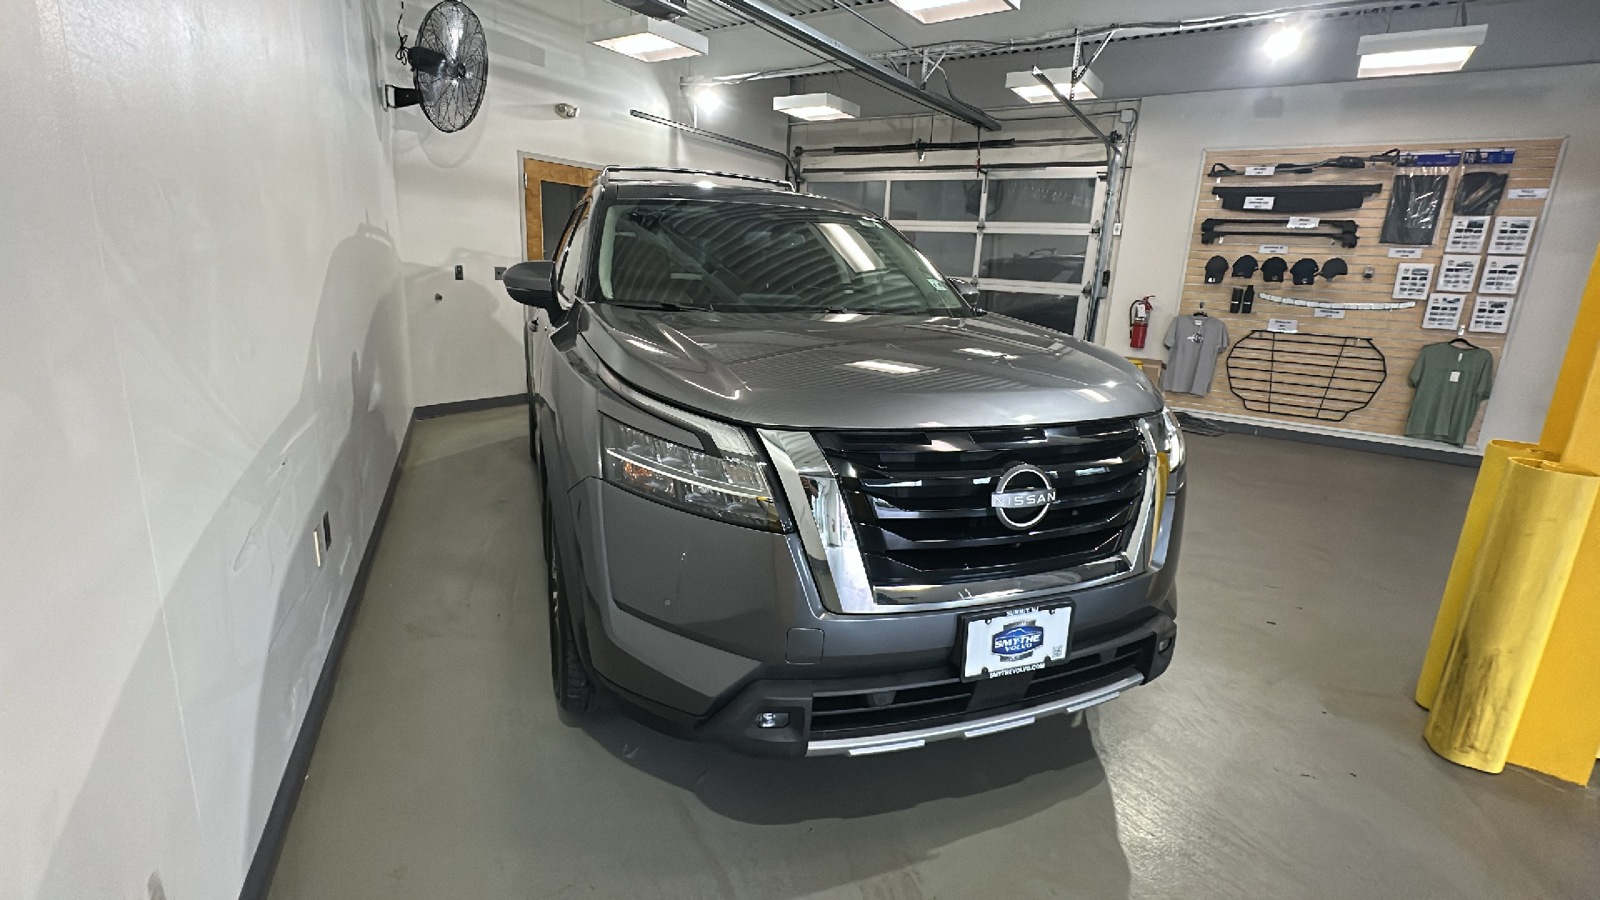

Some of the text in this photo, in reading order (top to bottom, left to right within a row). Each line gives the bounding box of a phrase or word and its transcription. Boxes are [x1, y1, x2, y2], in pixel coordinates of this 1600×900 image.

[994, 491, 1056, 506] NISSAN
[995, 634, 1041, 649] SMYTHE
[1005, 642, 1033, 652] VOLVO
